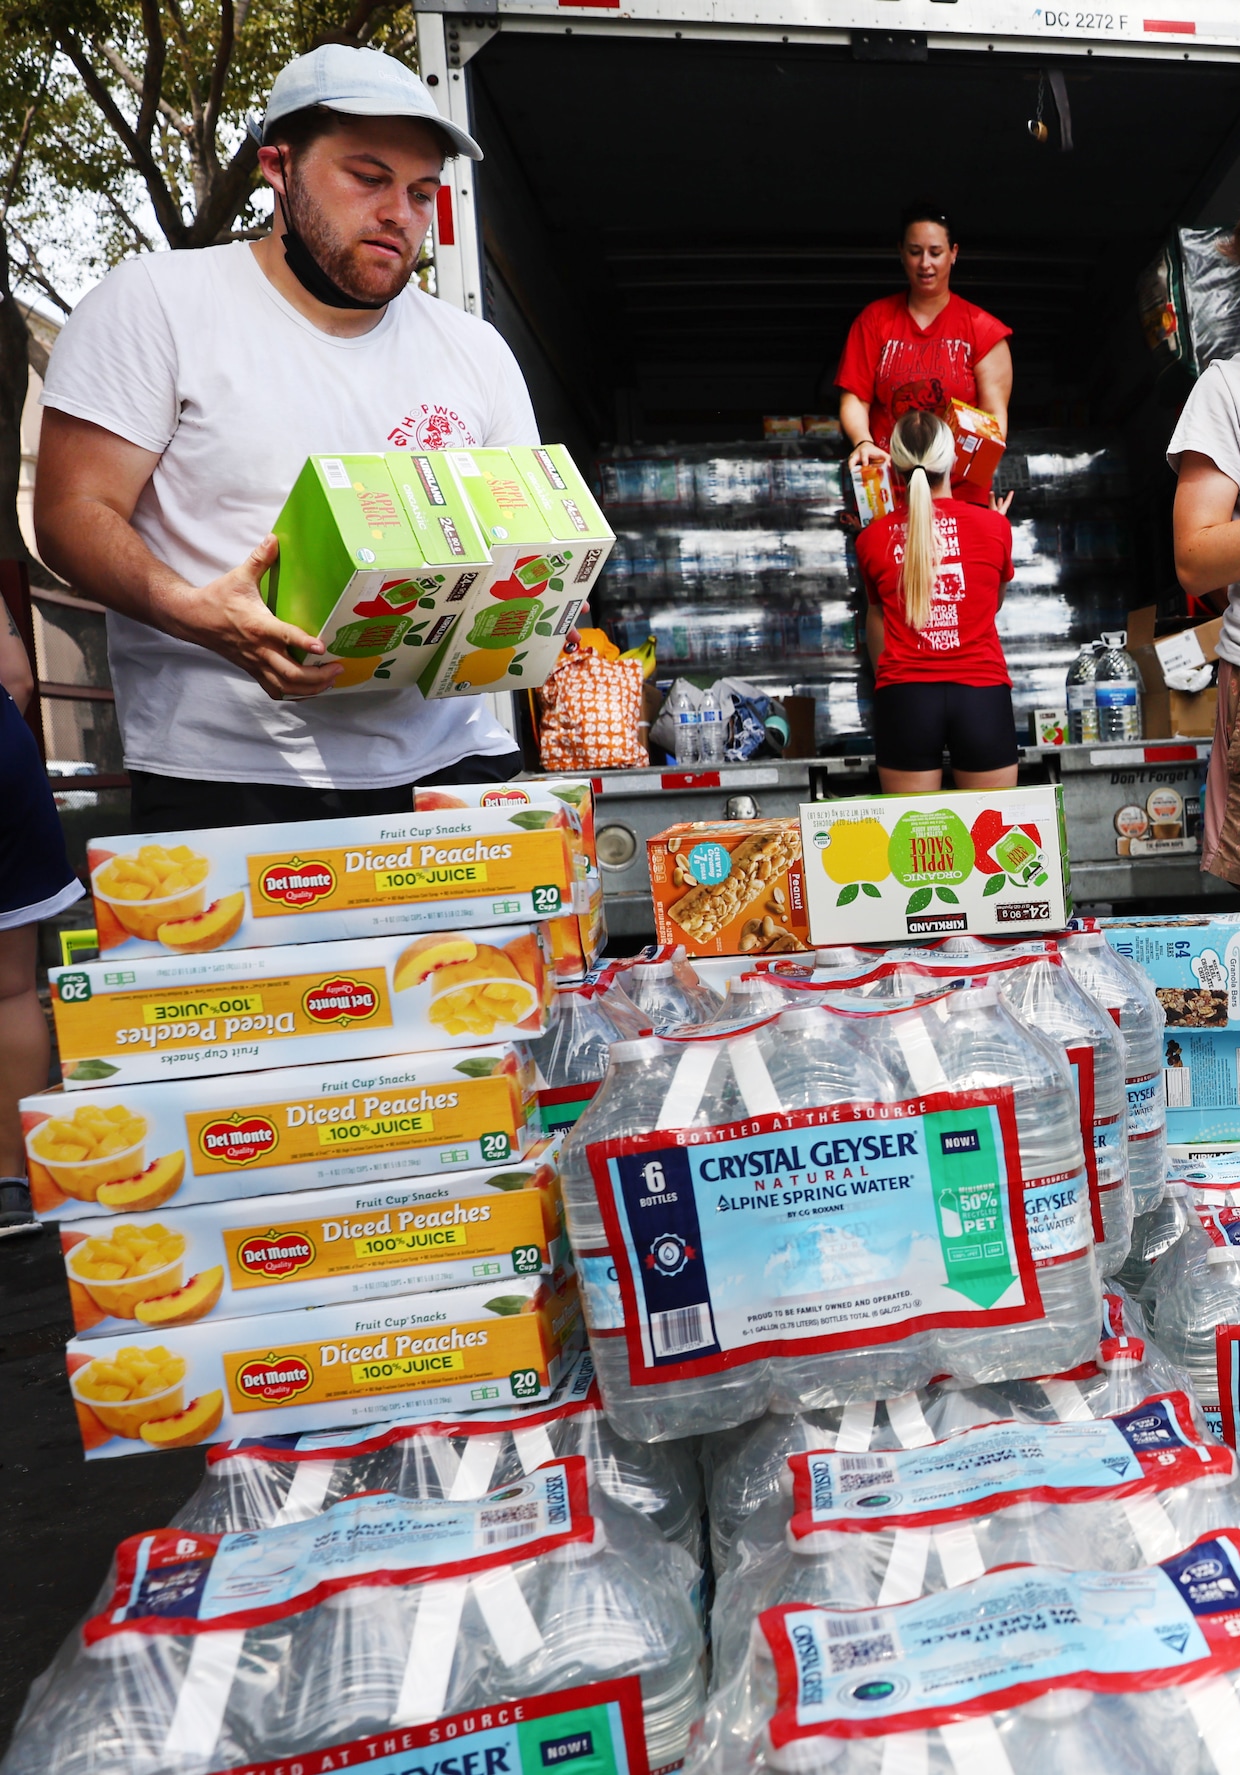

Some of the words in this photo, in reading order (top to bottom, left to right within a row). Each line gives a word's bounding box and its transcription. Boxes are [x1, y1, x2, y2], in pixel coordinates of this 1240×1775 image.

[1045, 11, 1070, 27] DC
[1076, 13, 1114, 29] 2272
[1120, 15, 1128, 30] F
[539, 449, 567, 489] KIRKLAND
[418, 457, 444, 505] KIRKLAND
[487, 479, 514, 510] SAUCE
[501, 479, 530, 510] APPLE
[357, 492, 383, 528] SAUCE
[376, 492, 402, 528] APPLE
[403, 484, 426, 531] ORGANIC
[516, 610, 528, 637] APPLE
[517, 604, 539, 640] ORGANIC
[560, 601, 581, 635] KIRKLAND
[431, 615, 455, 644] KIRKLAND
[1111, 771, 1145, 785] Don't
[1148, 770, 1189, 783] Forget
[485, 797, 500, 807] Del
[501, 796, 528, 807] Monte
[380, 828, 406, 839] Fruit
[410, 827, 432, 838] Cup
[436, 823, 472, 835] Snacks
[908, 835, 953, 854] SAUCE
[345, 851, 413, 873] Diced
[421, 840, 512, 868] Peaches
[910, 853, 955, 873] APPLE
[266, 877, 290, 891] Del
[291, 874, 331, 889] Monte
[386, 871, 425, 888] 100%
[426, 868, 477, 884] JUICE
[903, 870, 963, 882] ORGANIC
[536, 888, 558, 904] 20
[792, 873, 803, 910] Peanut
[909, 920, 965, 933] KIRKLAND
[1166, 942, 1175, 958] BARS
[1175, 941, 1191, 958] 64
[1230, 958, 1238, 987] Granola
[62, 981, 87, 1000] 20
[156, 1003, 208, 1018] JUICE
[209, 998, 251, 1014] 100%
[309, 996, 351, 1011] Monte
[353, 994, 373, 1008] Del
[225, 1012, 295, 1033] Diced
[116, 1019, 217, 1047] Peaches
[286, 1105, 356, 1128] Diced
[363, 1090, 459, 1118] Peaches
[330, 1124, 369, 1140] 100%
[371, 1118, 422, 1135] JUICE
[676, 1122, 761, 1146] BOTTLED
[773, 1116, 793, 1130] AT
[806, 1110, 841, 1126] THE
[853, 1100, 928, 1119] SOURCE
[206, 1133, 229, 1147] Del
[230, 1129, 272, 1145] Monte
[485, 1134, 507, 1151] 20
[945, 1135, 976, 1149] NOW!
[700, 1146, 806, 1182] CRYSTAL
[809, 1131, 918, 1166] GEYSER
[644, 1160, 667, 1194] 6
[754, 1165, 869, 1191] NATURAL
[1041, 1173, 1069, 1186] SOURCE
[639, 1191, 678, 1208] BOTTLES
[716, 1191, 779, 1214] ALPINE
[783, 1184, 849, 1205] SPRING
[850, 1175, 911, 1194] WATER
[960, 1191, 998, 1211] 50%
[1024, 1190, 1077, 1216] GEYSER
[322, 1219, 392, 1243] Diced
[398, 1203, 491, 1232] Peaches
[963, 1216, 997, 1233] PET
[1047, 1217, 1076, 1234] WATER
[366, 1237, 405, 1254] 100%
[407, 1231, 456, 1248] JUICE
[245, 1249, 267, 1264] Del
[268, 1244, 309, 1260] Monte
[516, 1248, 539, 1264] 20
[747, 1311, 773, 1323] PROUD
[774, 1310, 783, 1318] TO
[784, 1308, 794, 1316] BE
[797, 1304, 822, 1315] FAMILY
[825, 1302, 852, 1312] OWNED
[855, 1298, 870, 1307] AND
[873, 1290, 913, 1303] OPERATED.
[320, 1343, 389, 1367] Diced
[396, 1328, 488, 1356] Peaches
[363, 1362, 402, 1379] 100%
[403, 1356, 453, 1373] JUICE
[243, 1374, 266, 1388] Del
[266, 1368, 307, 1385] Monte
[514, 1373, 537, 1389] 20
[1159, 1454, 1176, 1466] 6
[175, 1538, 196, 1554] 6
[793, 1624, 820, 1672] CRYSTAL
[322, 1750, 351, 1770] AT
[367, 1734, 412, 1759] THE
[428, 1706, 526, 1744] SOURCE
[547, 1738, 589, 1760] NOW!
